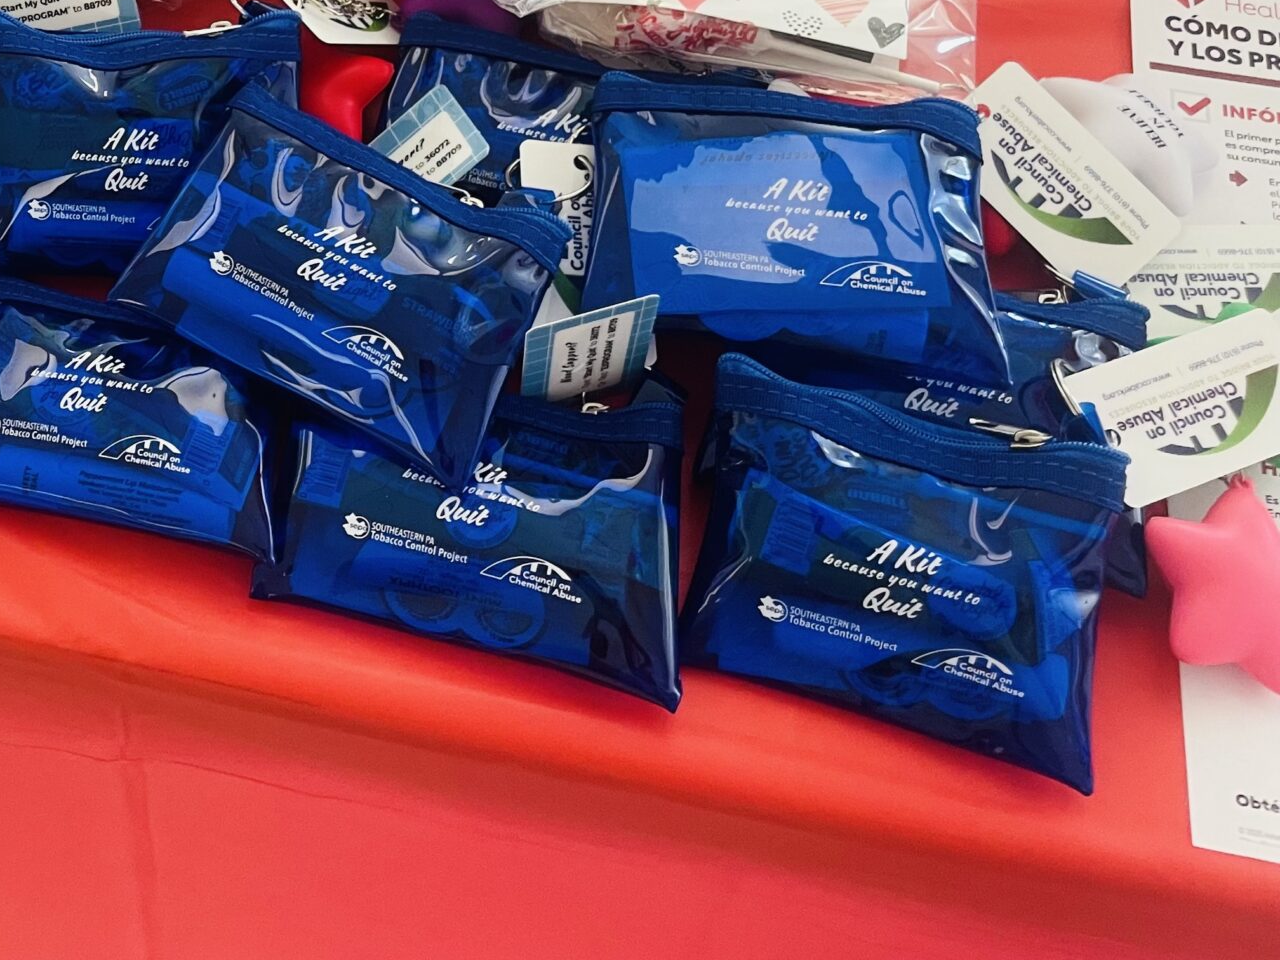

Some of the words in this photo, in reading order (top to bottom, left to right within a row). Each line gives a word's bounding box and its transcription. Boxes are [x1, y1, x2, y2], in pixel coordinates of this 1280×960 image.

[24, 0, 38, 9] My
[73, 5, 83, 13] to
[1164, 15, 1251, 43] CÓMO
[1167, 38, 1184, 56] Y
[1191, 42, 1243, 66] LOS
[103, 128, 122, 150] A
[124, 129, 160, 150] Kit
[992, 112, 1034, 153] Abuse
[1116, 105, 1168, 149] BELIEVE
[1224, 129, 1234, 138] El
[1236, 132, 1272, 144] primer
[424, 139, 451, 164] 36072
[434, 143, 462, 169] 88709
[997, 137, 1017, 156] on
[1227, 153, 1239, 161] su
[104, 168, 149, 191] Quit
[1013, 156, 1065, 205] Council
[1031, 153, 1092, 212] Chemical
[314, 225, 337, 240] A
[339, 231, 379, 260] Kit
[766, 218, 820, 242] Quit
[570, 215, 584, 271] Council
[297, 257, 346, 292] Quit
[1187, 272, 1260, 286] Chemical
[1154, 288, 1174, 297] on
[1181, 286, 1240, 300] Council
[65, 351, 85, 369] A
[88, 352, 126, 374] Kit
[60, 388, 108, 412] Quit
[903, 387, 960, 418] Quit
[1167, 381, 1239, 412] Chemical
[1116, 407, 1165, 431] Abuse
[1168, 404, 1227, 436] Council
[1146, 425, 1166, 439] on
[436, 496, 489, 526] Quit
[863, 586, 924, 620] Quit
